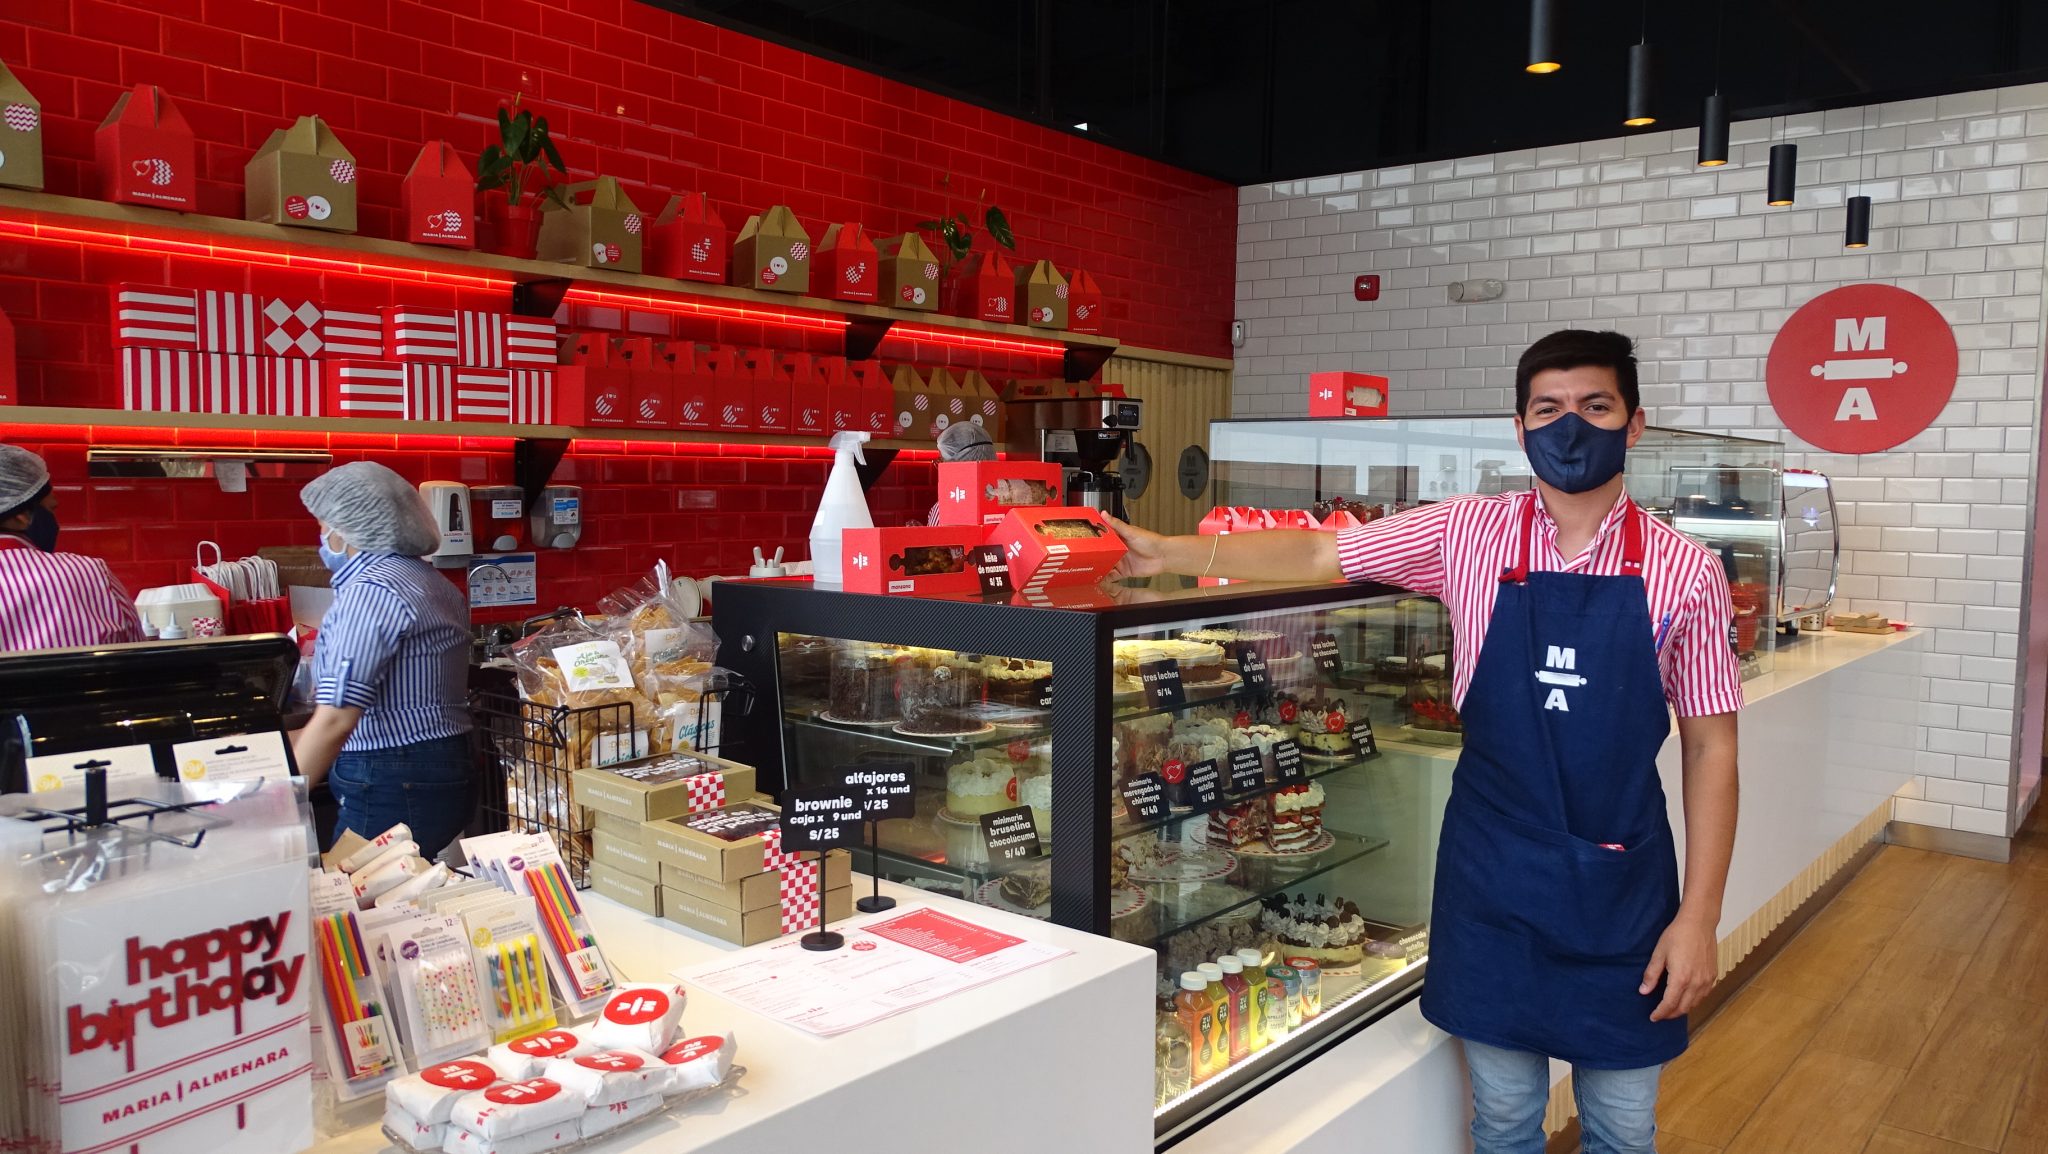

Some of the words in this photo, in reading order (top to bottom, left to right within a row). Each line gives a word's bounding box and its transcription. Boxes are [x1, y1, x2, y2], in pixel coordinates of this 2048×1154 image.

[1834, 316, 1886, 352] M
[1834, 387, 1878, 421] A
[1186, 456, 1196, 467] M
[1187, 479, 1194, 490] A
[984, 553, 998, 563] keke
[978, 566, 985, 574] de
[986, 565, 1008, 574] manzana
[1546, 645, 1576, 670] M
[1243, 663, 1251, 672] de
[1251, 661, 1265, 671] limón
[1143, 672, 1157, 682] tres
[1158, 671, 1179, 681] leches
[1544, 688, 1569, 712] A
[845, 771, 906, 786] alfajores
[876, 786, 888, 794] 16
[890, 785, 910, 794] und
[795, 796, 853, 812] brownie
[790, 814, 815, 826] caja
[832, 812, 840, 821] 9
[841, 810, 862, 820] und
[992, 813, 1023, 826] minimaria
[990, 821, 1031, 837] bruselina
[989, 831, 1036, 848] chocolúcuma
[445, 919, 453, 927] 12
[125, 911, 292, 986] happy
[67, 953, 306, 1055] birthday
[1220, 1012, 1227, 1020] MA
[102, 1091, 171, 1124] MARIA
[188, 1046, 290, 1094] ALMENARA
